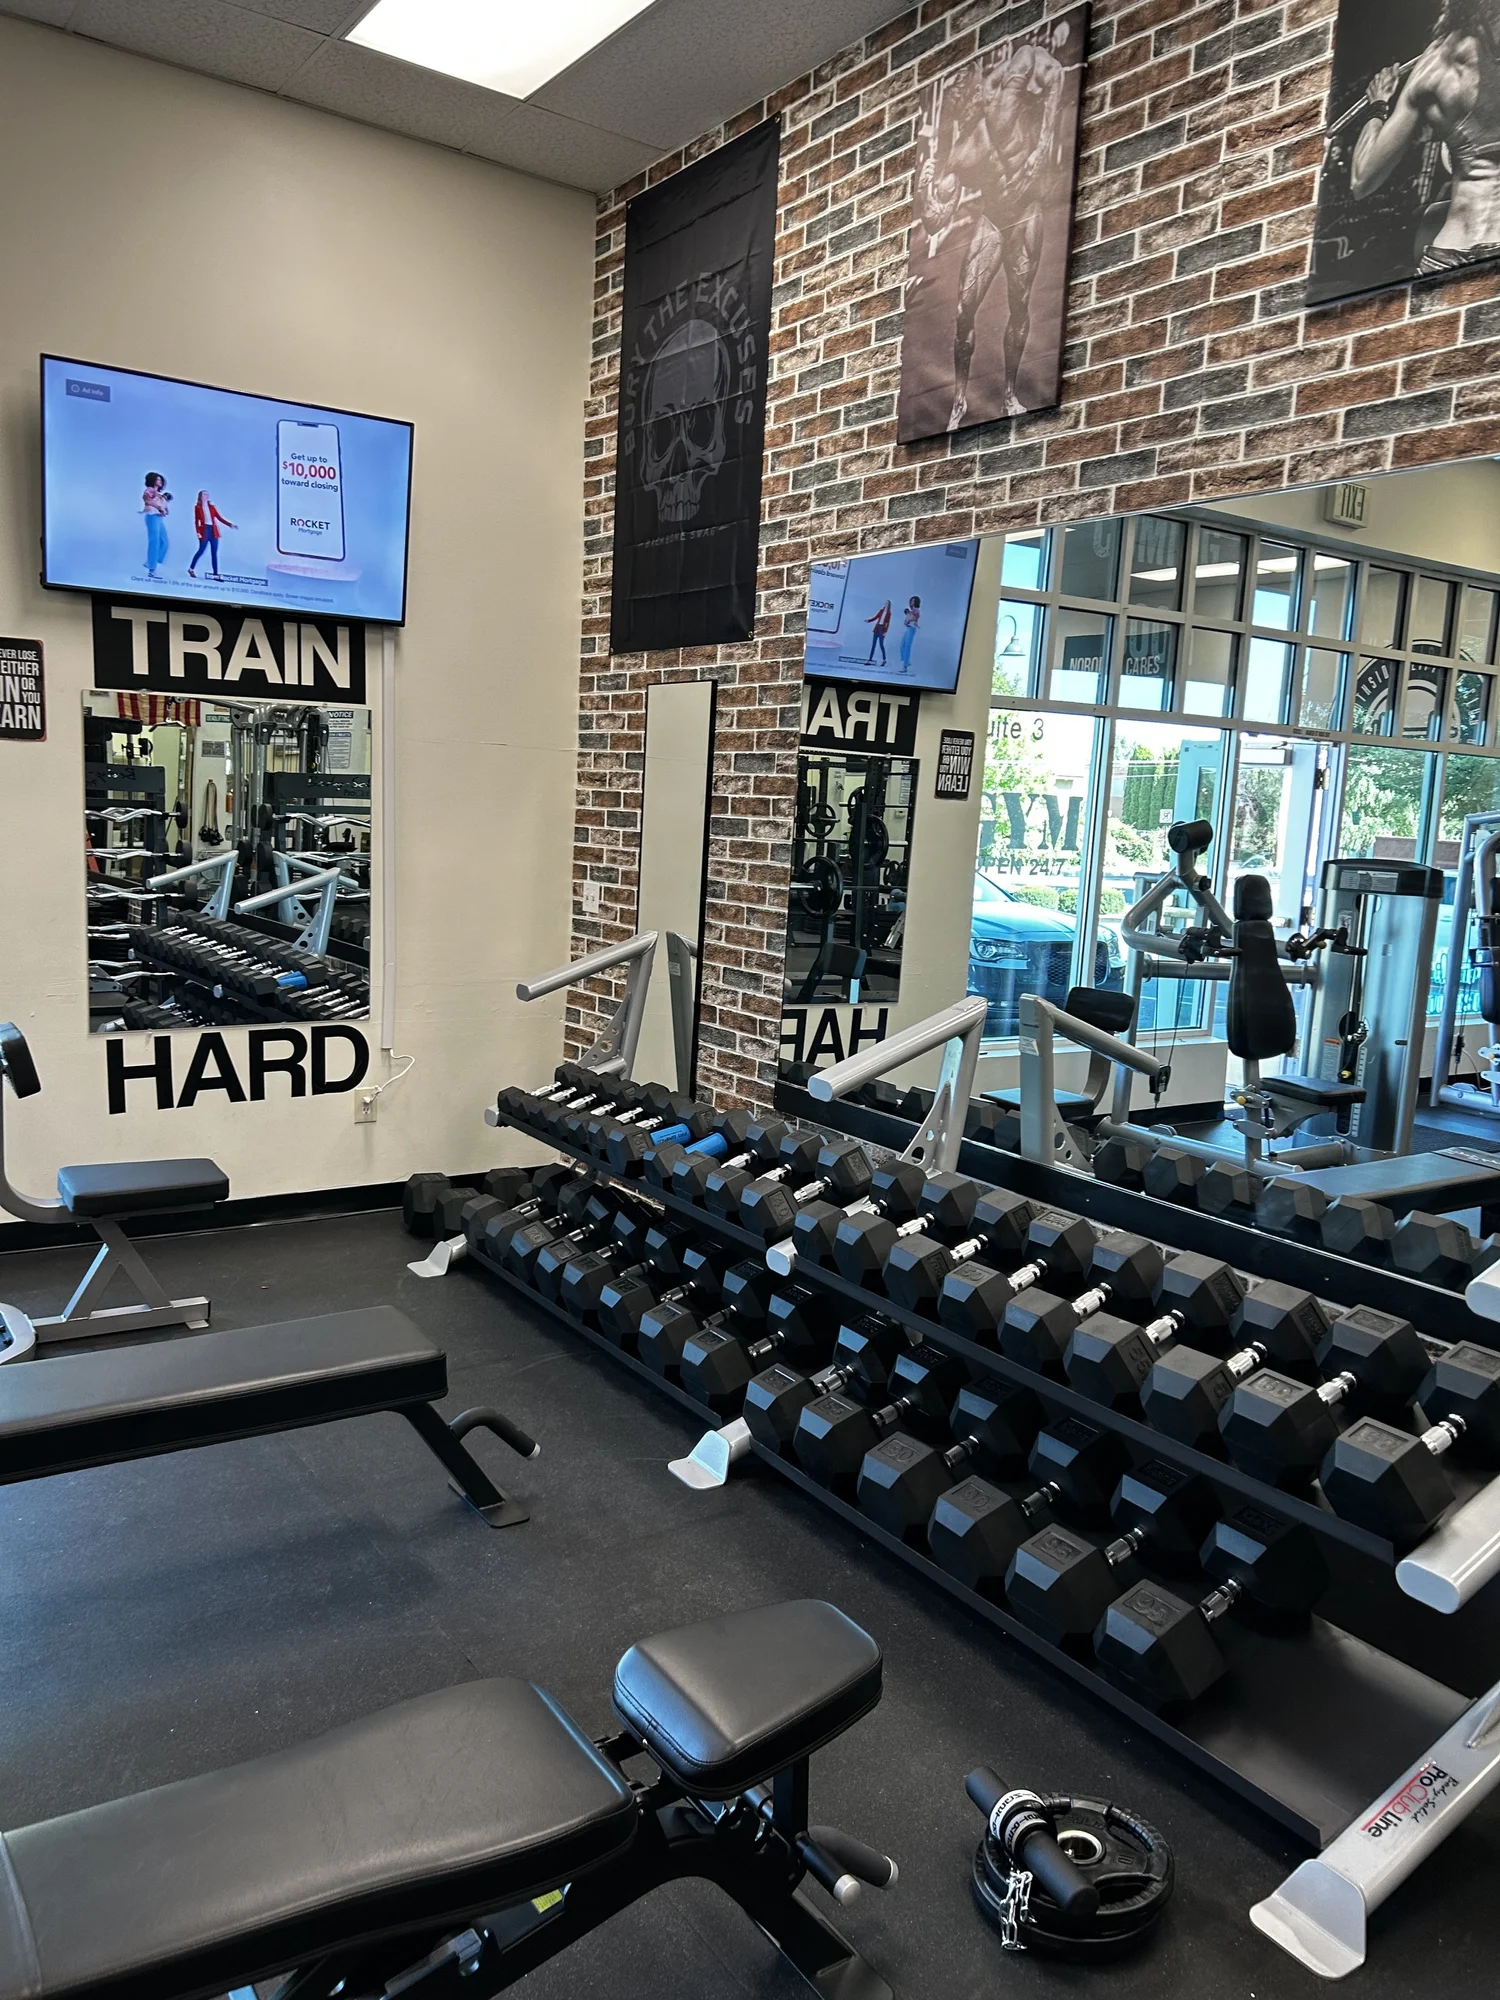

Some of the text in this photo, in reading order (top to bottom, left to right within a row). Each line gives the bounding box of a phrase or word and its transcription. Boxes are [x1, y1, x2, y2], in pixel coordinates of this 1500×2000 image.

[643, 278, 689, 342] THE
[695, 272, 757, 424] EXCUSES
[291, 453, 305, 461] Get
[283, 461, 336, 480] $10,000
[281, 478, 338, 492] toward closing
[290, 518, 330, 530] ROCKET
[298, 528, 322, 536] Mortgage
[111, 606, 350, 689] TRAIN
[1, 661, 39, 676] EITHER
[1126, 655, 1160, 675] CARES
[0, 675, 36, 703] IN OR
[22, 691, 40, 704] YOU
[0, 704, 41, 730] ARN
[329, 711, 353, 719] NOTICE
[987, 714, 1044, 741] uite 3
[105, 1024, 370, 1115] HARD
